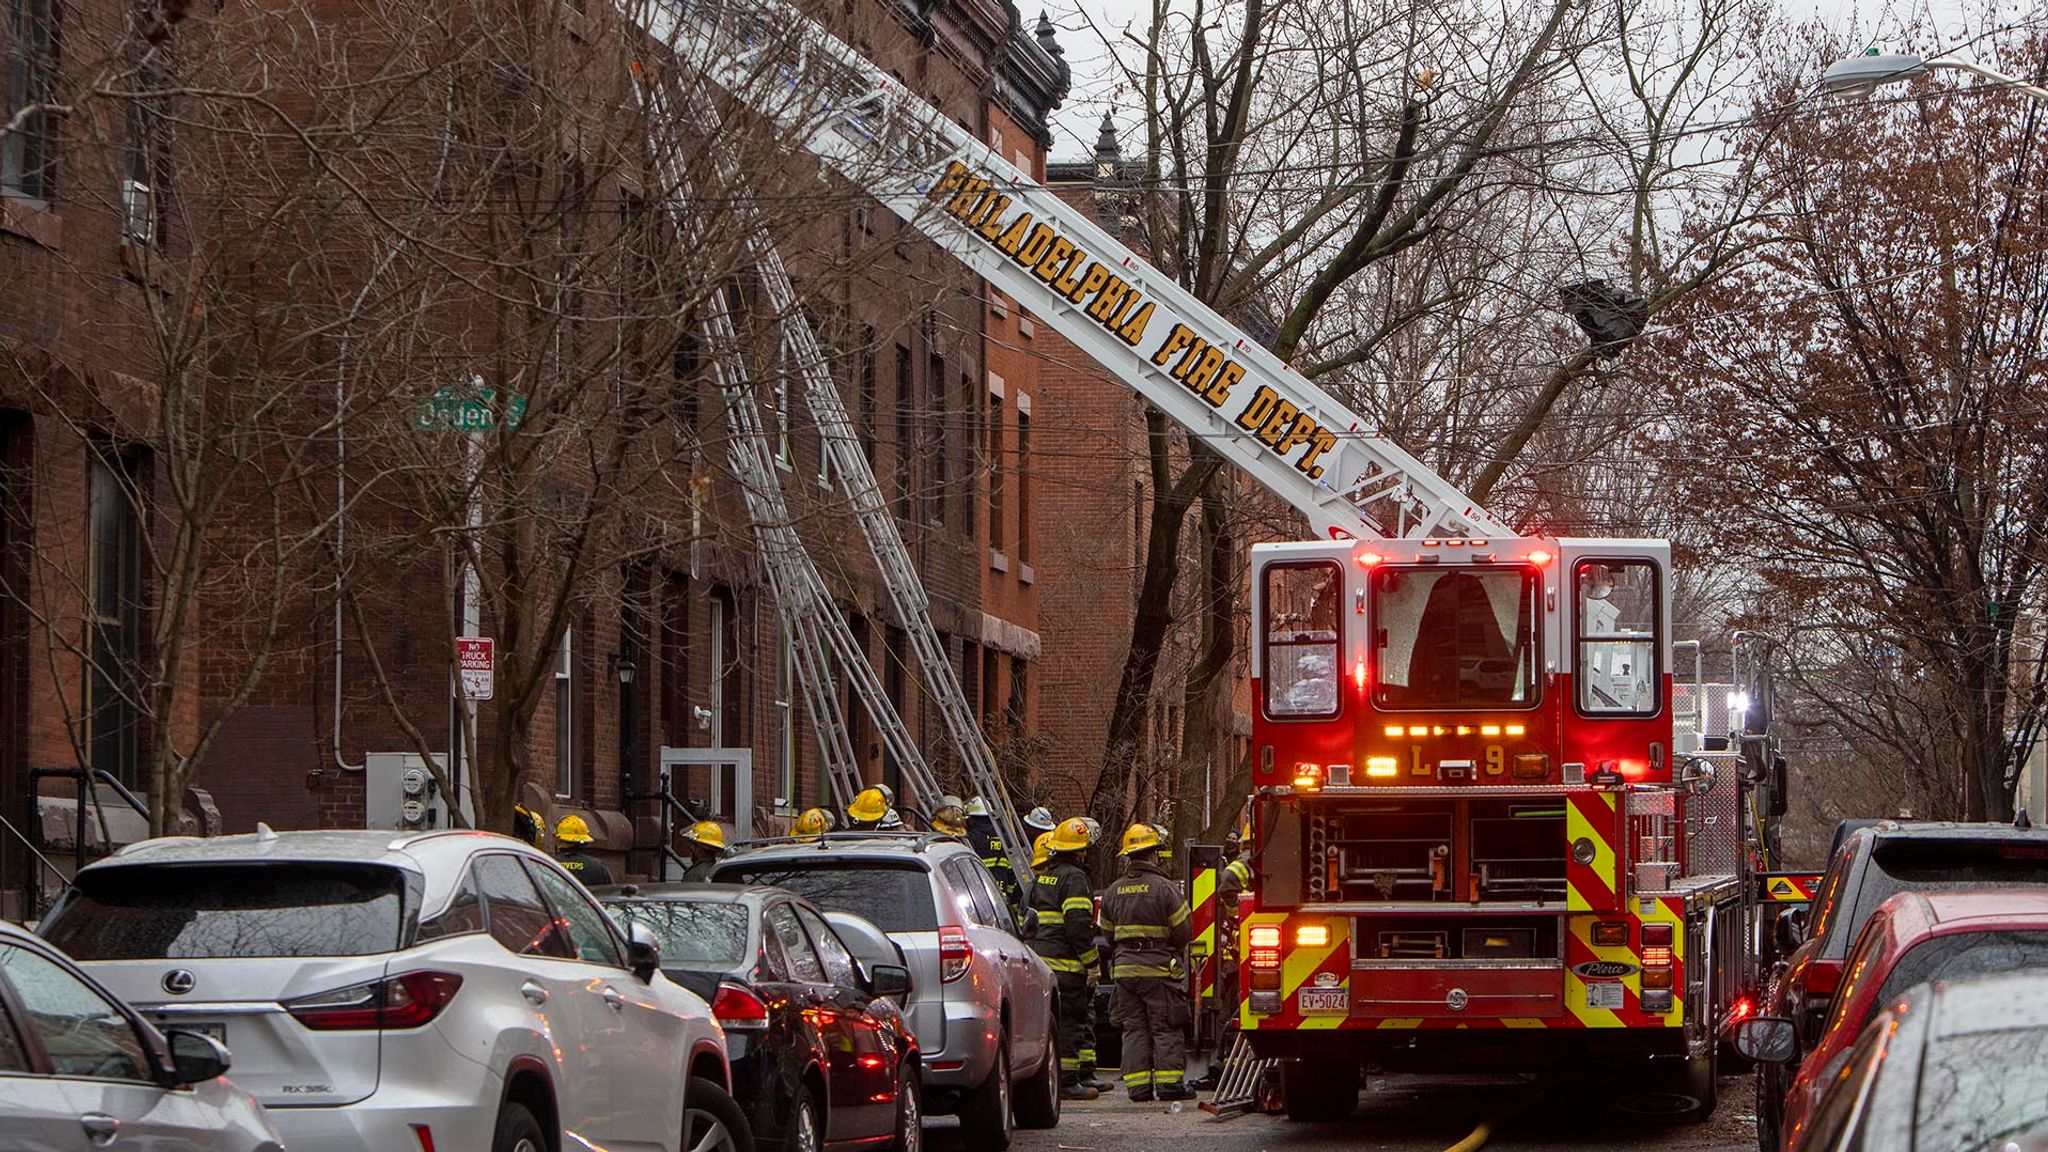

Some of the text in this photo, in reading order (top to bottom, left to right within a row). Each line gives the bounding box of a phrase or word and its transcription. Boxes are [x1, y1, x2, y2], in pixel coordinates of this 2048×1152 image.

[1129, 261, 1139, 271] 80
[926, 160, 1337, 479] PHILADELPHIA FIRE DEPT.
[1242, 344, 1251, 353] 70
[1470, 512, 1481, 522] 50
[468, 643, 480, 651] NO
[461, 651, 487, 660] TRUCK
[1411, 744, 1504, 775] L 9
[1586, 963, 1624, 975] Pierce
